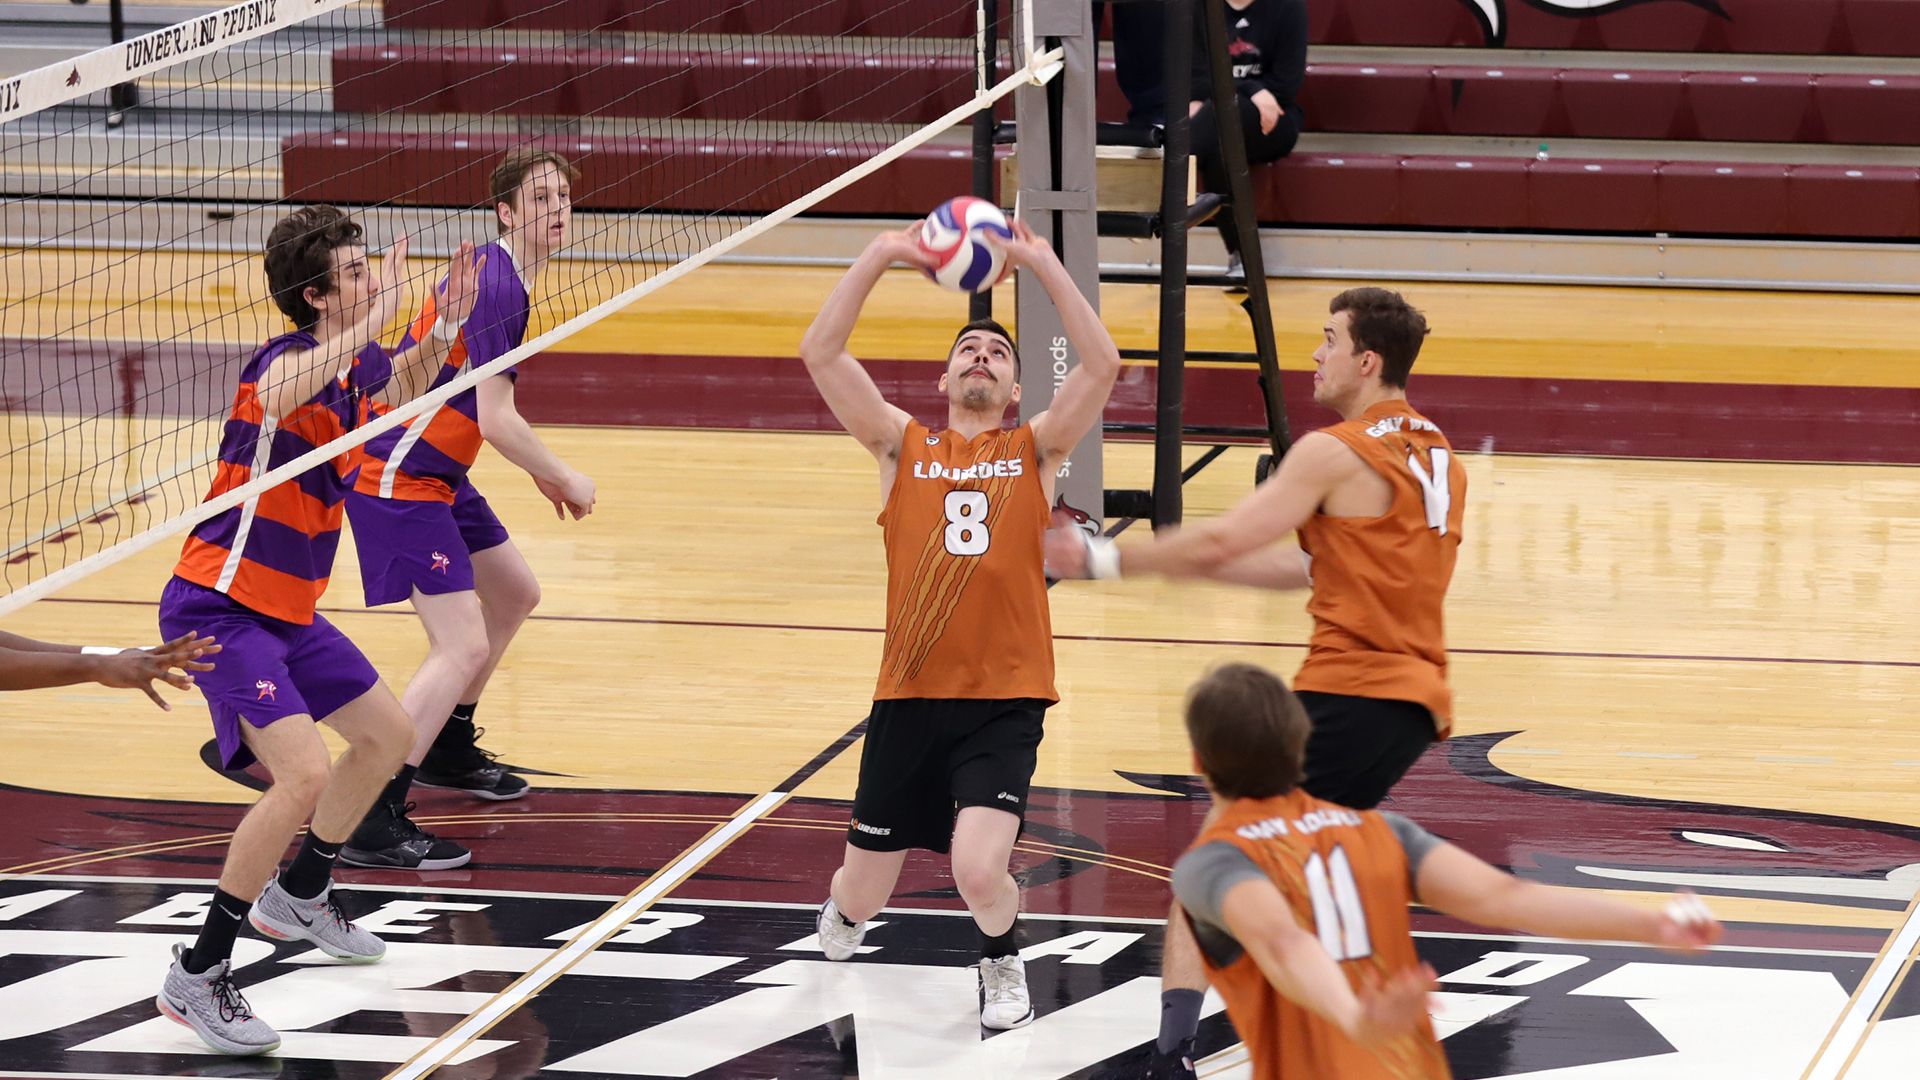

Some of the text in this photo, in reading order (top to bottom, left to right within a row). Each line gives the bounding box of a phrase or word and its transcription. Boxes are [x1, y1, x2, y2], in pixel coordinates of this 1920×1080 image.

[126, 0, 276, 71] CUMBERLAND PHOENIX
[913, 458, 1023, 481] LOURDES
[944, 489, 990, 556] 8
[1303, 843, 1372, 961] 11
